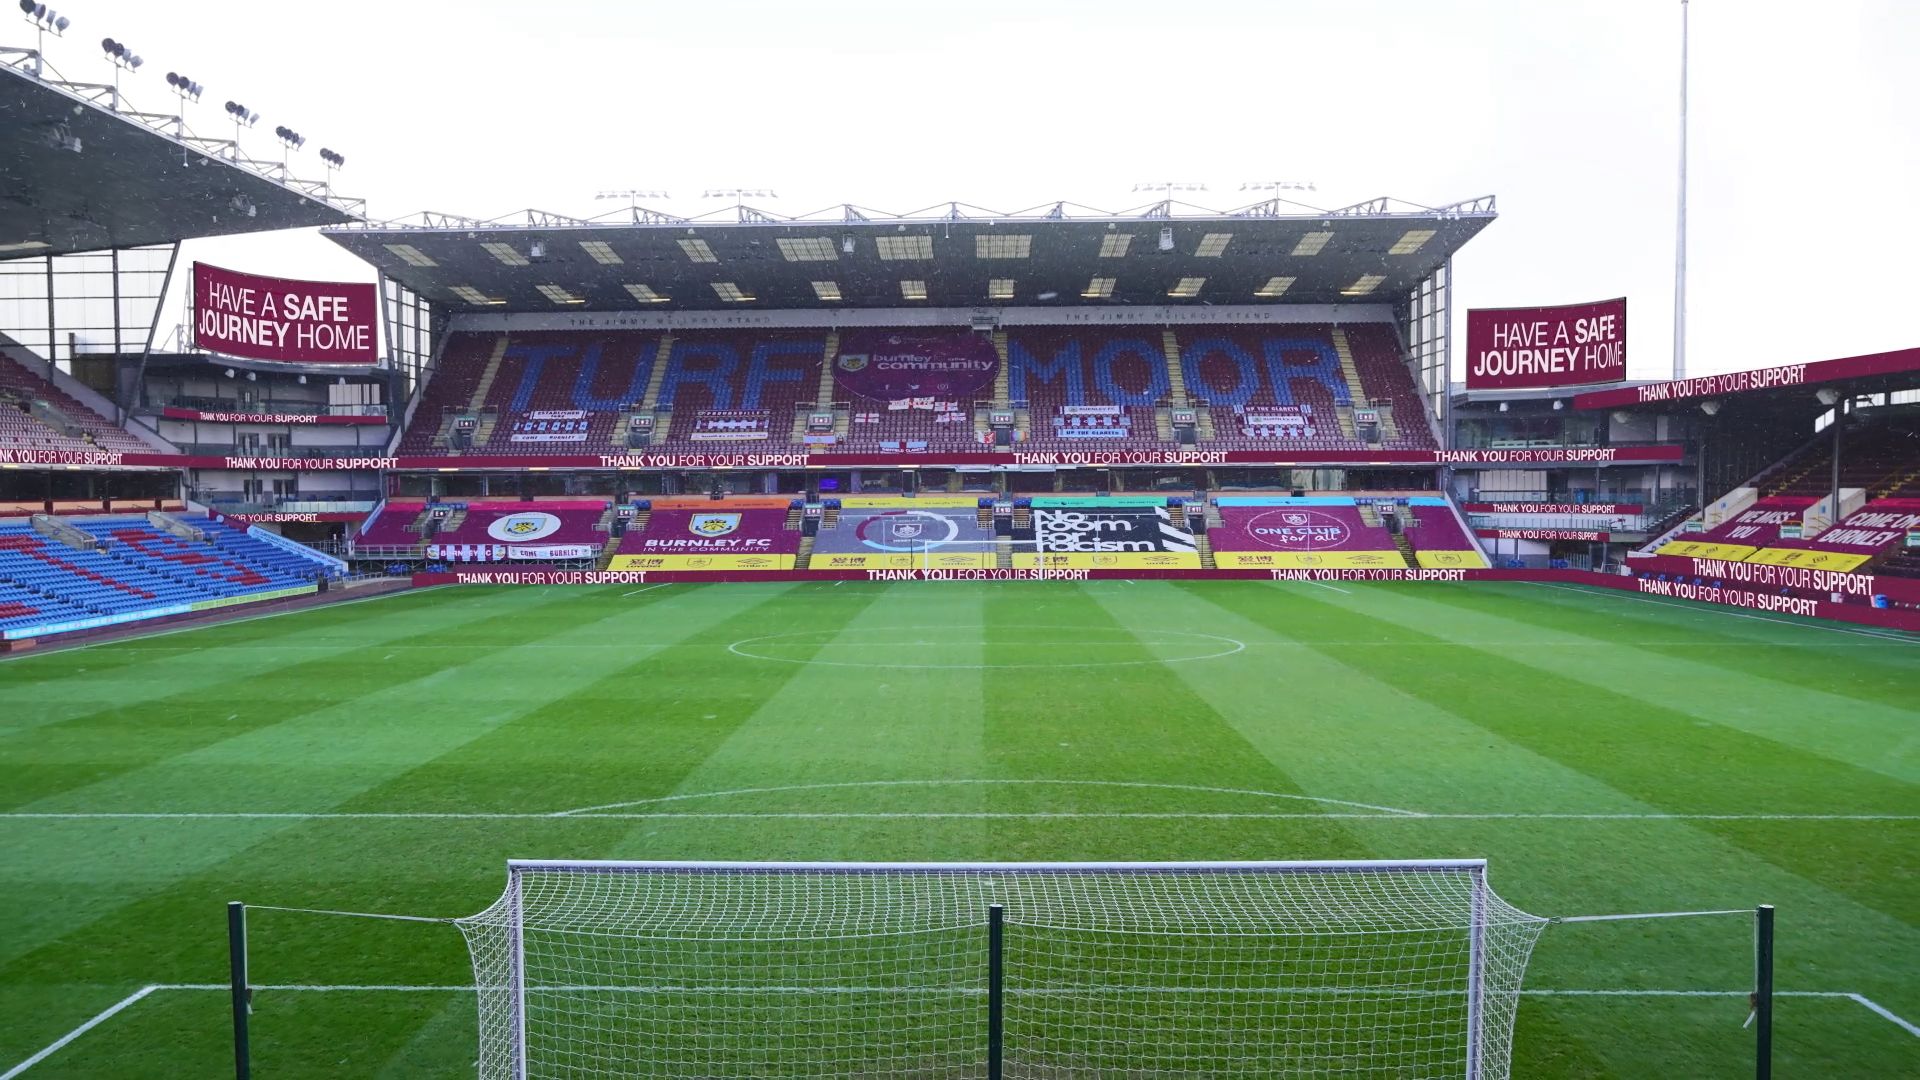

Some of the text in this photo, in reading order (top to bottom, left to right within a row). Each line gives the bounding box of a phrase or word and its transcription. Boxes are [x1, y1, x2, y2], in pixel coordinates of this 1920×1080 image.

[210, 281, 348, 322] HAVE A SAFE
[200, 308, 370, 350] JOURNEY HOME
[1494, 315, 1616, 348] HAVE A SAFE
[873, 354, 931, 363] burnley
[1474, 341, 1622, 376] JOURNEY HOME
[877, 360, 993, 371] community
[503, 337, 1351, 412] TURF MOOR
[1638, 365, 1806, 402] THANK YOU FOR YOUR SUPPORT
[200, 412, 317, 423] THANK YOU FOR YOUR SUPPORT
[16, 450, 36, 462] YOU
[39, 450, 56, 463] FOR
[59, 452, 82, 464] YOUR
[84, 453, 122, 464] SUPPORT
[600, 455, 809, 466] THANK YOU FOR YOUR SUPPORT
[1013, 452, 1228, 464] THANK YOU FOR YOUR SUPPORT
[1434, 449, 1616, 462] THANK YOU FOR YOUR SUPPORT
[225, 456, 398, 469] THANK YOU FOR YOUR SUPPORT
[1493, 504, 1615, 514] THANK YOU FOR YOUR SUPPORT
[248, 514, 272, 522] YOUR
[274, 514, 317, 522] SUPPORT
[1034, 510, 1085, 522] No
[1736, 511, 1796, 524] WE MISS
[1845, 512, 1903, 527] COME
[1035, 520, 1131, 531] room
[1036, 531, 1086, 543] for
[1280, 533, 1338, 543] for all
[1499, 530, 1598, 540] THANK YOU FOR YOUR SUPPORT
[1726, 525, 1761, 539] YOU
[1818, 528, 1902, 546] BURNLEY
[645, 539, 772, 547] BURNLEY FC
[1037, 538, 1155, 552] racism
[457, 572, 646, 584] THANK YOU FOR YOUR SUPPORT
[867, 570, 1090, 580] THANK YOU FOR YOUR SUPPORT
[1271, 570, 1466, 580] THANK YOU FOR YOUR SUPPORT
[1692, 558, 1874, 596] THANK YOU FOR YOUR SUPPORT
[1638, 578, 1817, 616] THANK YOU FOR YOUR SUPPORT
